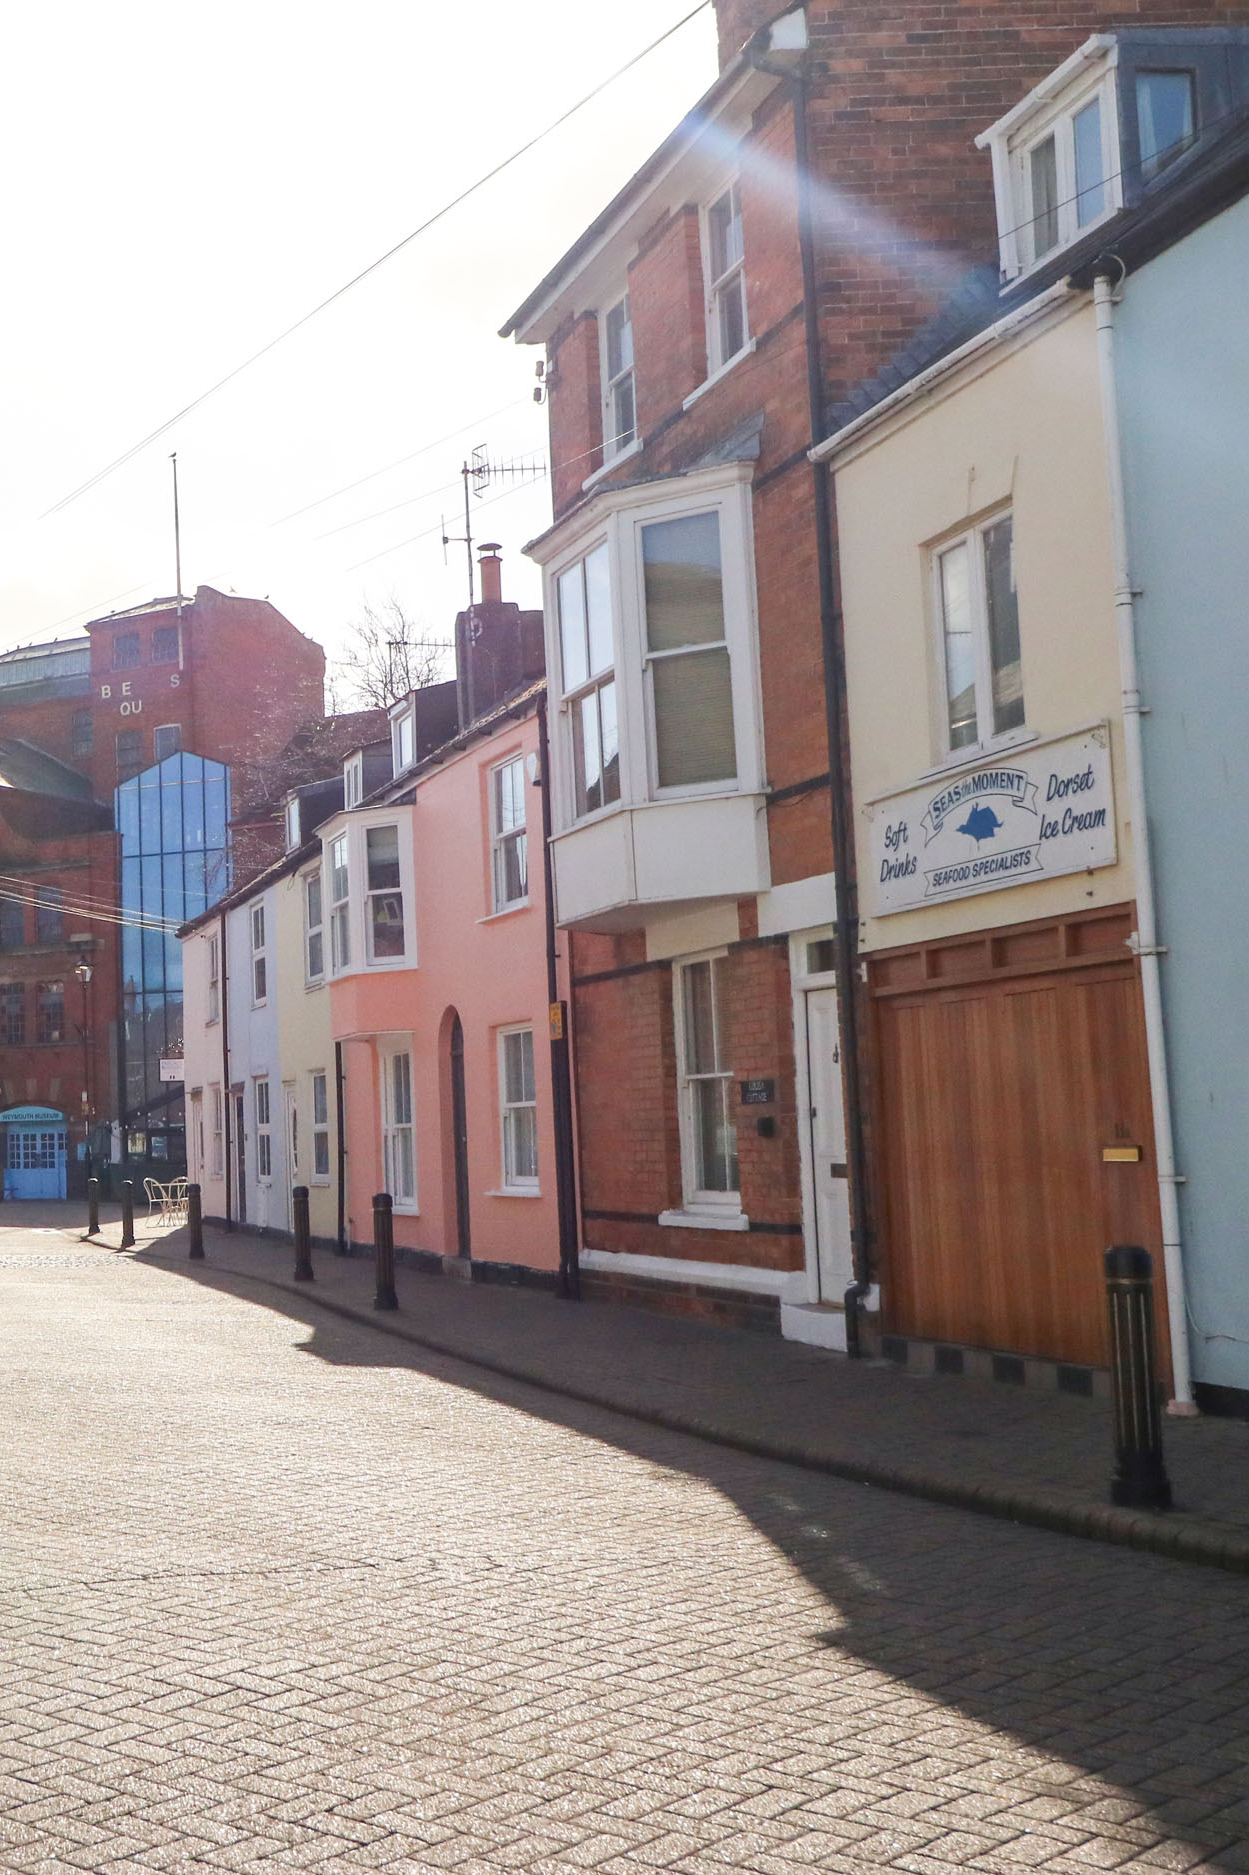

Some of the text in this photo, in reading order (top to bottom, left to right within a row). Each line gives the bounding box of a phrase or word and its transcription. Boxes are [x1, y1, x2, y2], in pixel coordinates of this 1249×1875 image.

[932, 785, 962, 819] SEAS
[972, 772, 1024, 793] MOMENT
[1046, 763, 1095, 802] Dorset
[884, 820, 909, 852] Soft
[1038, 806, 1107, 841] Ice Cream
[879, 852, 918, 884] Drinks
[932, 850, 1031, 887] SEAFOOD SPECIALISTS
